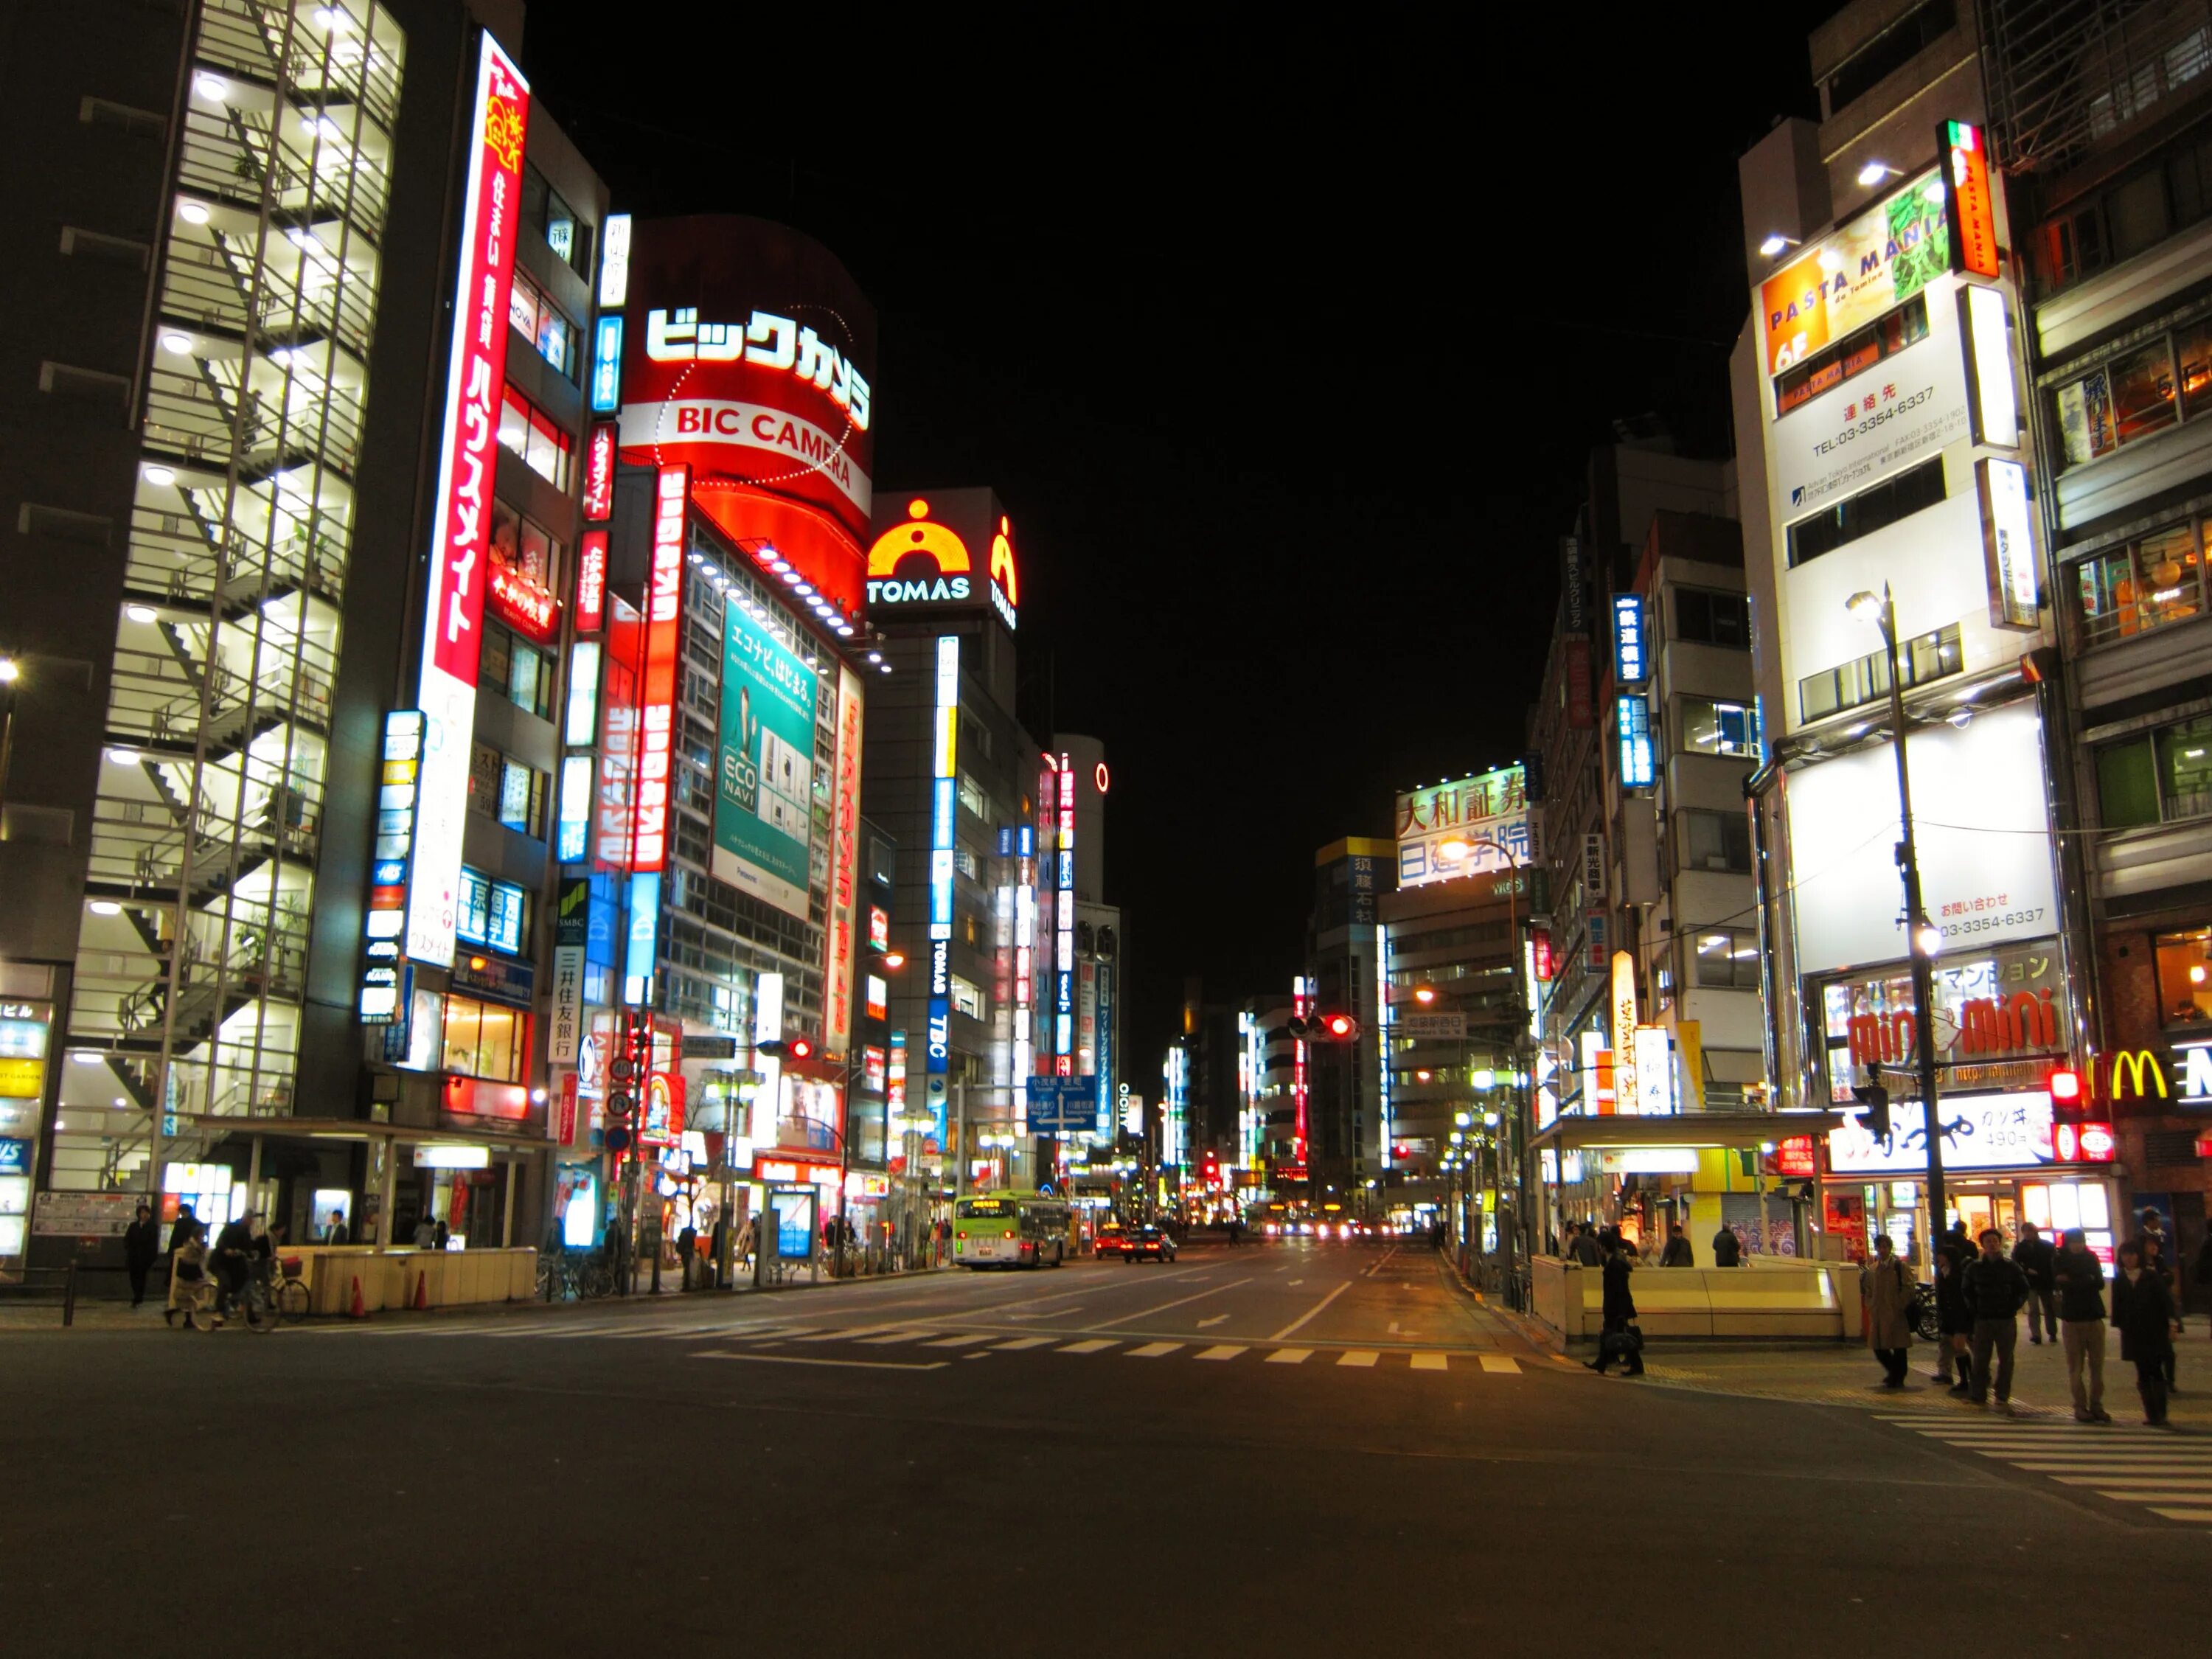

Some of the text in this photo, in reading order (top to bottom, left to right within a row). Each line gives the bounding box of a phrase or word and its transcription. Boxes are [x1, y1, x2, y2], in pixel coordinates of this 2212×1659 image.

[1963, 165, 1986, 270] PASTA MANIA
[1771, 206, 1948, 331] PASTA MANIA
[647, 307, 870, 431] ビックカメラ
[1775, 331, 1808, 369] 6F
[1813, 386, 1935, 458] TEL:03-3354-6337
[1843, 383, 1897, 422] 連絡先
[677, 407, 850, 490] BIC CAMERA
[447, 354, 493, 643] ハウスメイト
[866, 577, 970, 604] TOMAS
[990, 578, 1017, 630] TOMAS
[723, 752, 757, 791] ECO
[724, 779, 755, 807] NAVI
[558, 919, 585, 929] SMBC
[1940, 893, 2008, 917] お問い合わせ
[1940, 908, 2045, 939] 03-3354-6337
[933, 941, 947, 995] TOMAS
[1944, 956, 2049, 990] マンション
[555, 952, 578, 1057] 三井住友銀行
[1961, 987, 2056, 1054] mini
[929, 1015, 947, 1058] TBC
[613, 1062, 630, 1075] 40
